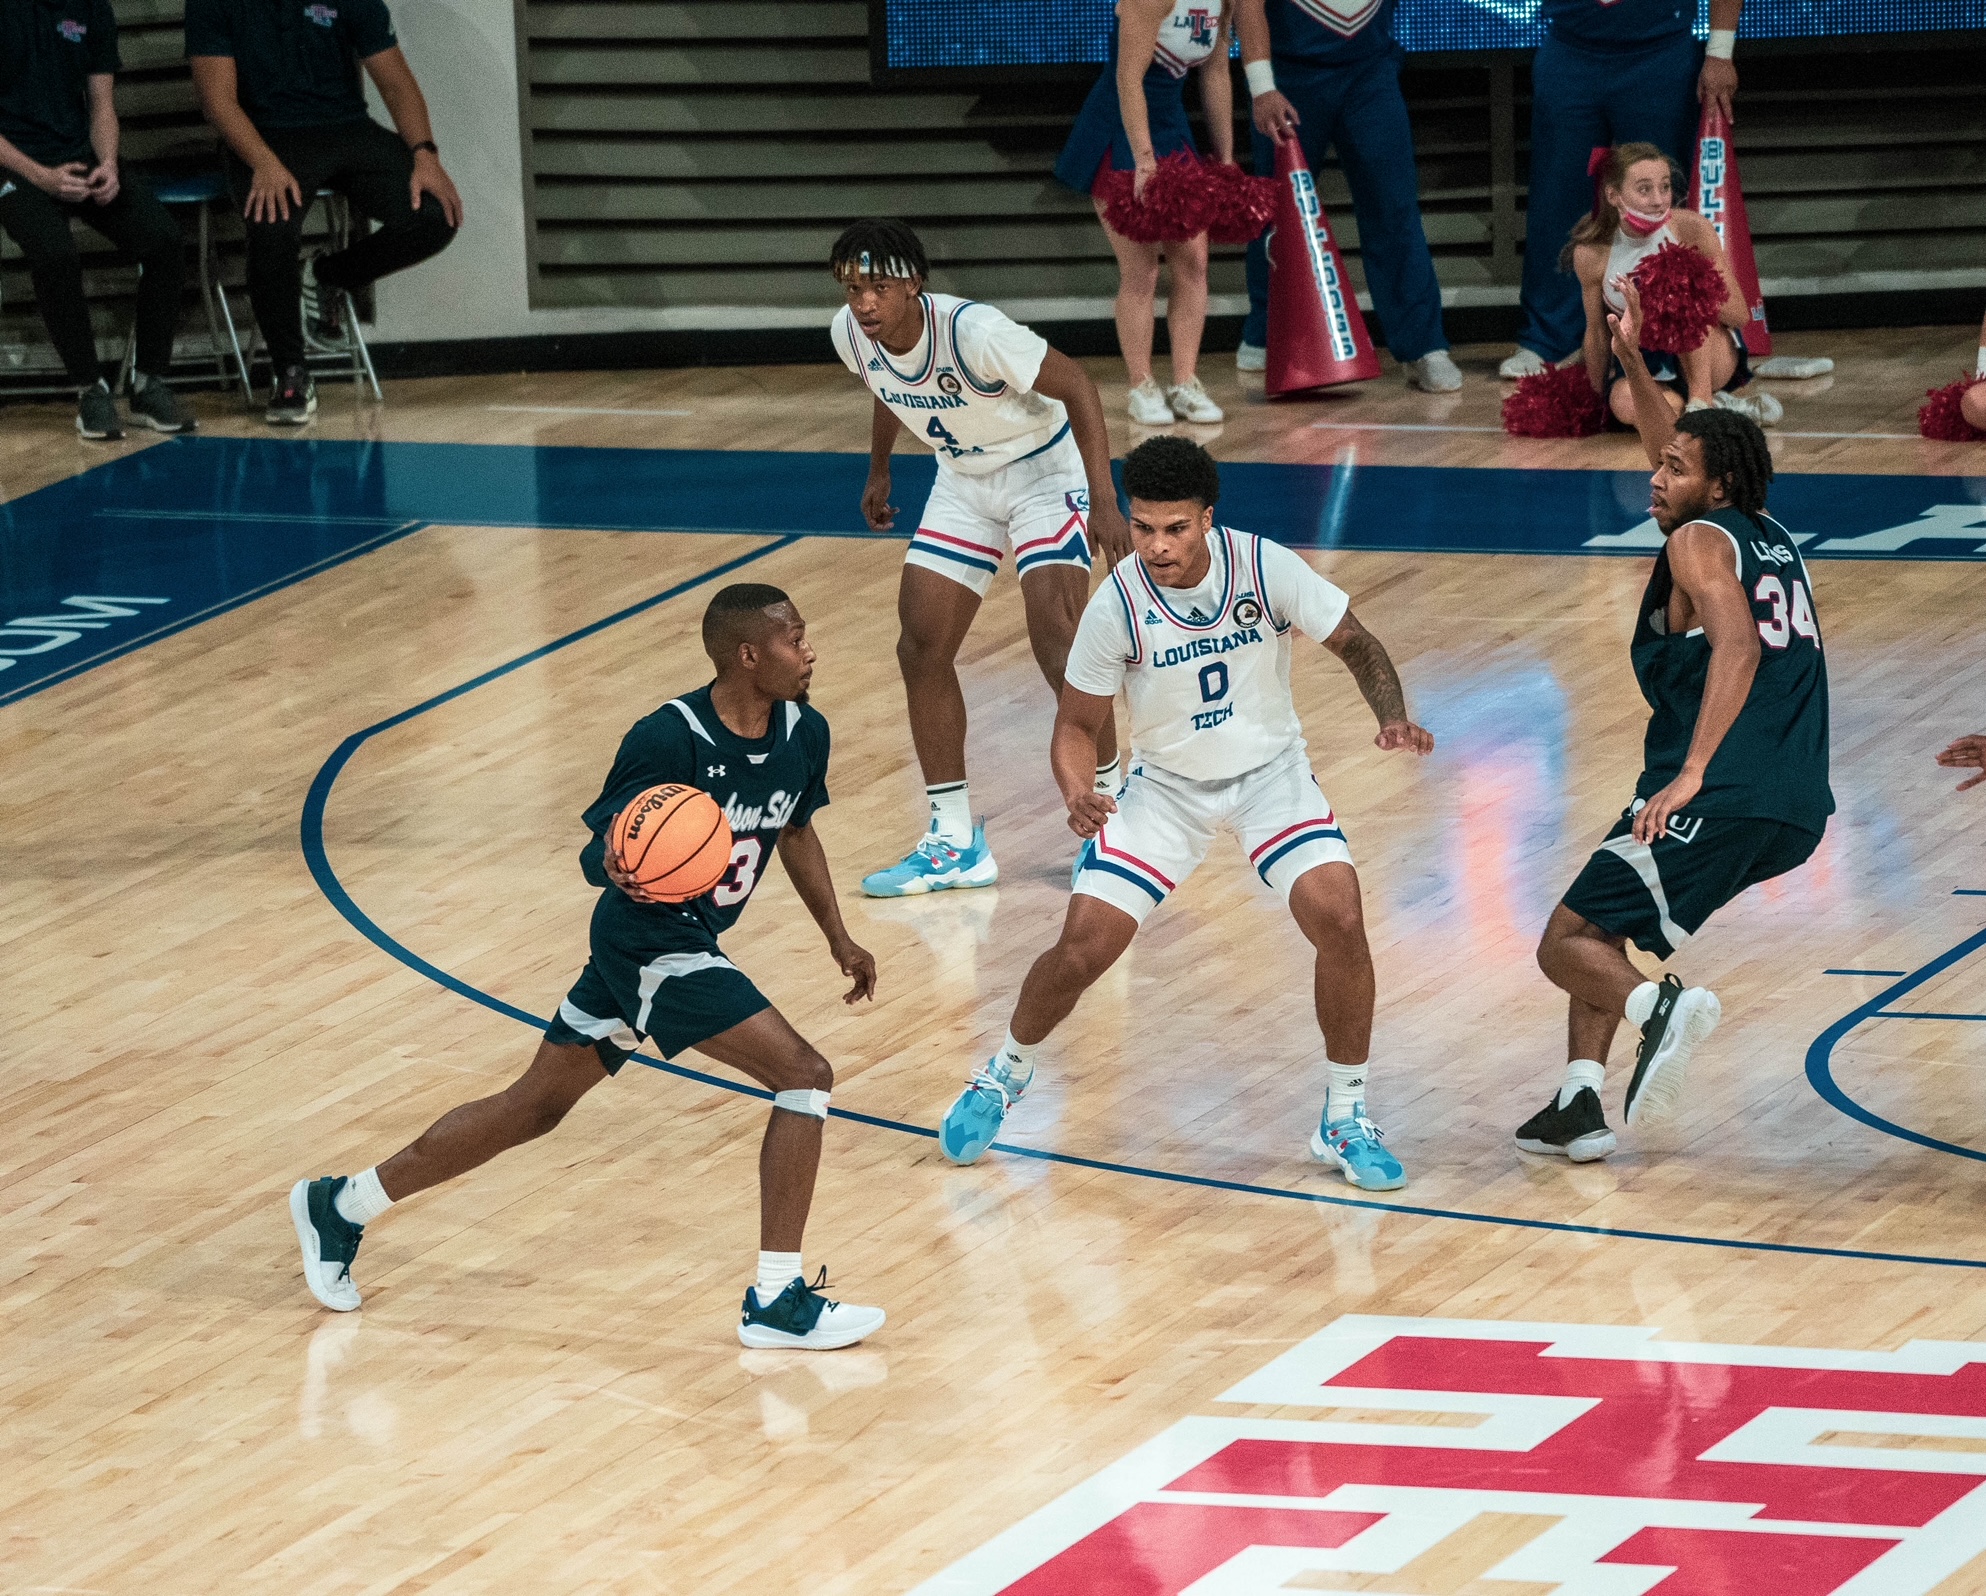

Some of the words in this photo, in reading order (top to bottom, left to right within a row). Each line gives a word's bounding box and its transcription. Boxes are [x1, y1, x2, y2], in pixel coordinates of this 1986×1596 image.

[926, 416, 959, 446] 4
[1754, 574, 1820, 651] 34
[1153, 628, 1263, 668] LOUISIANA
[1198, 661, 1229, 703] 0
[1191, 701, 1234, 731] TECH
[627, 785, 688, 841] Wilson
